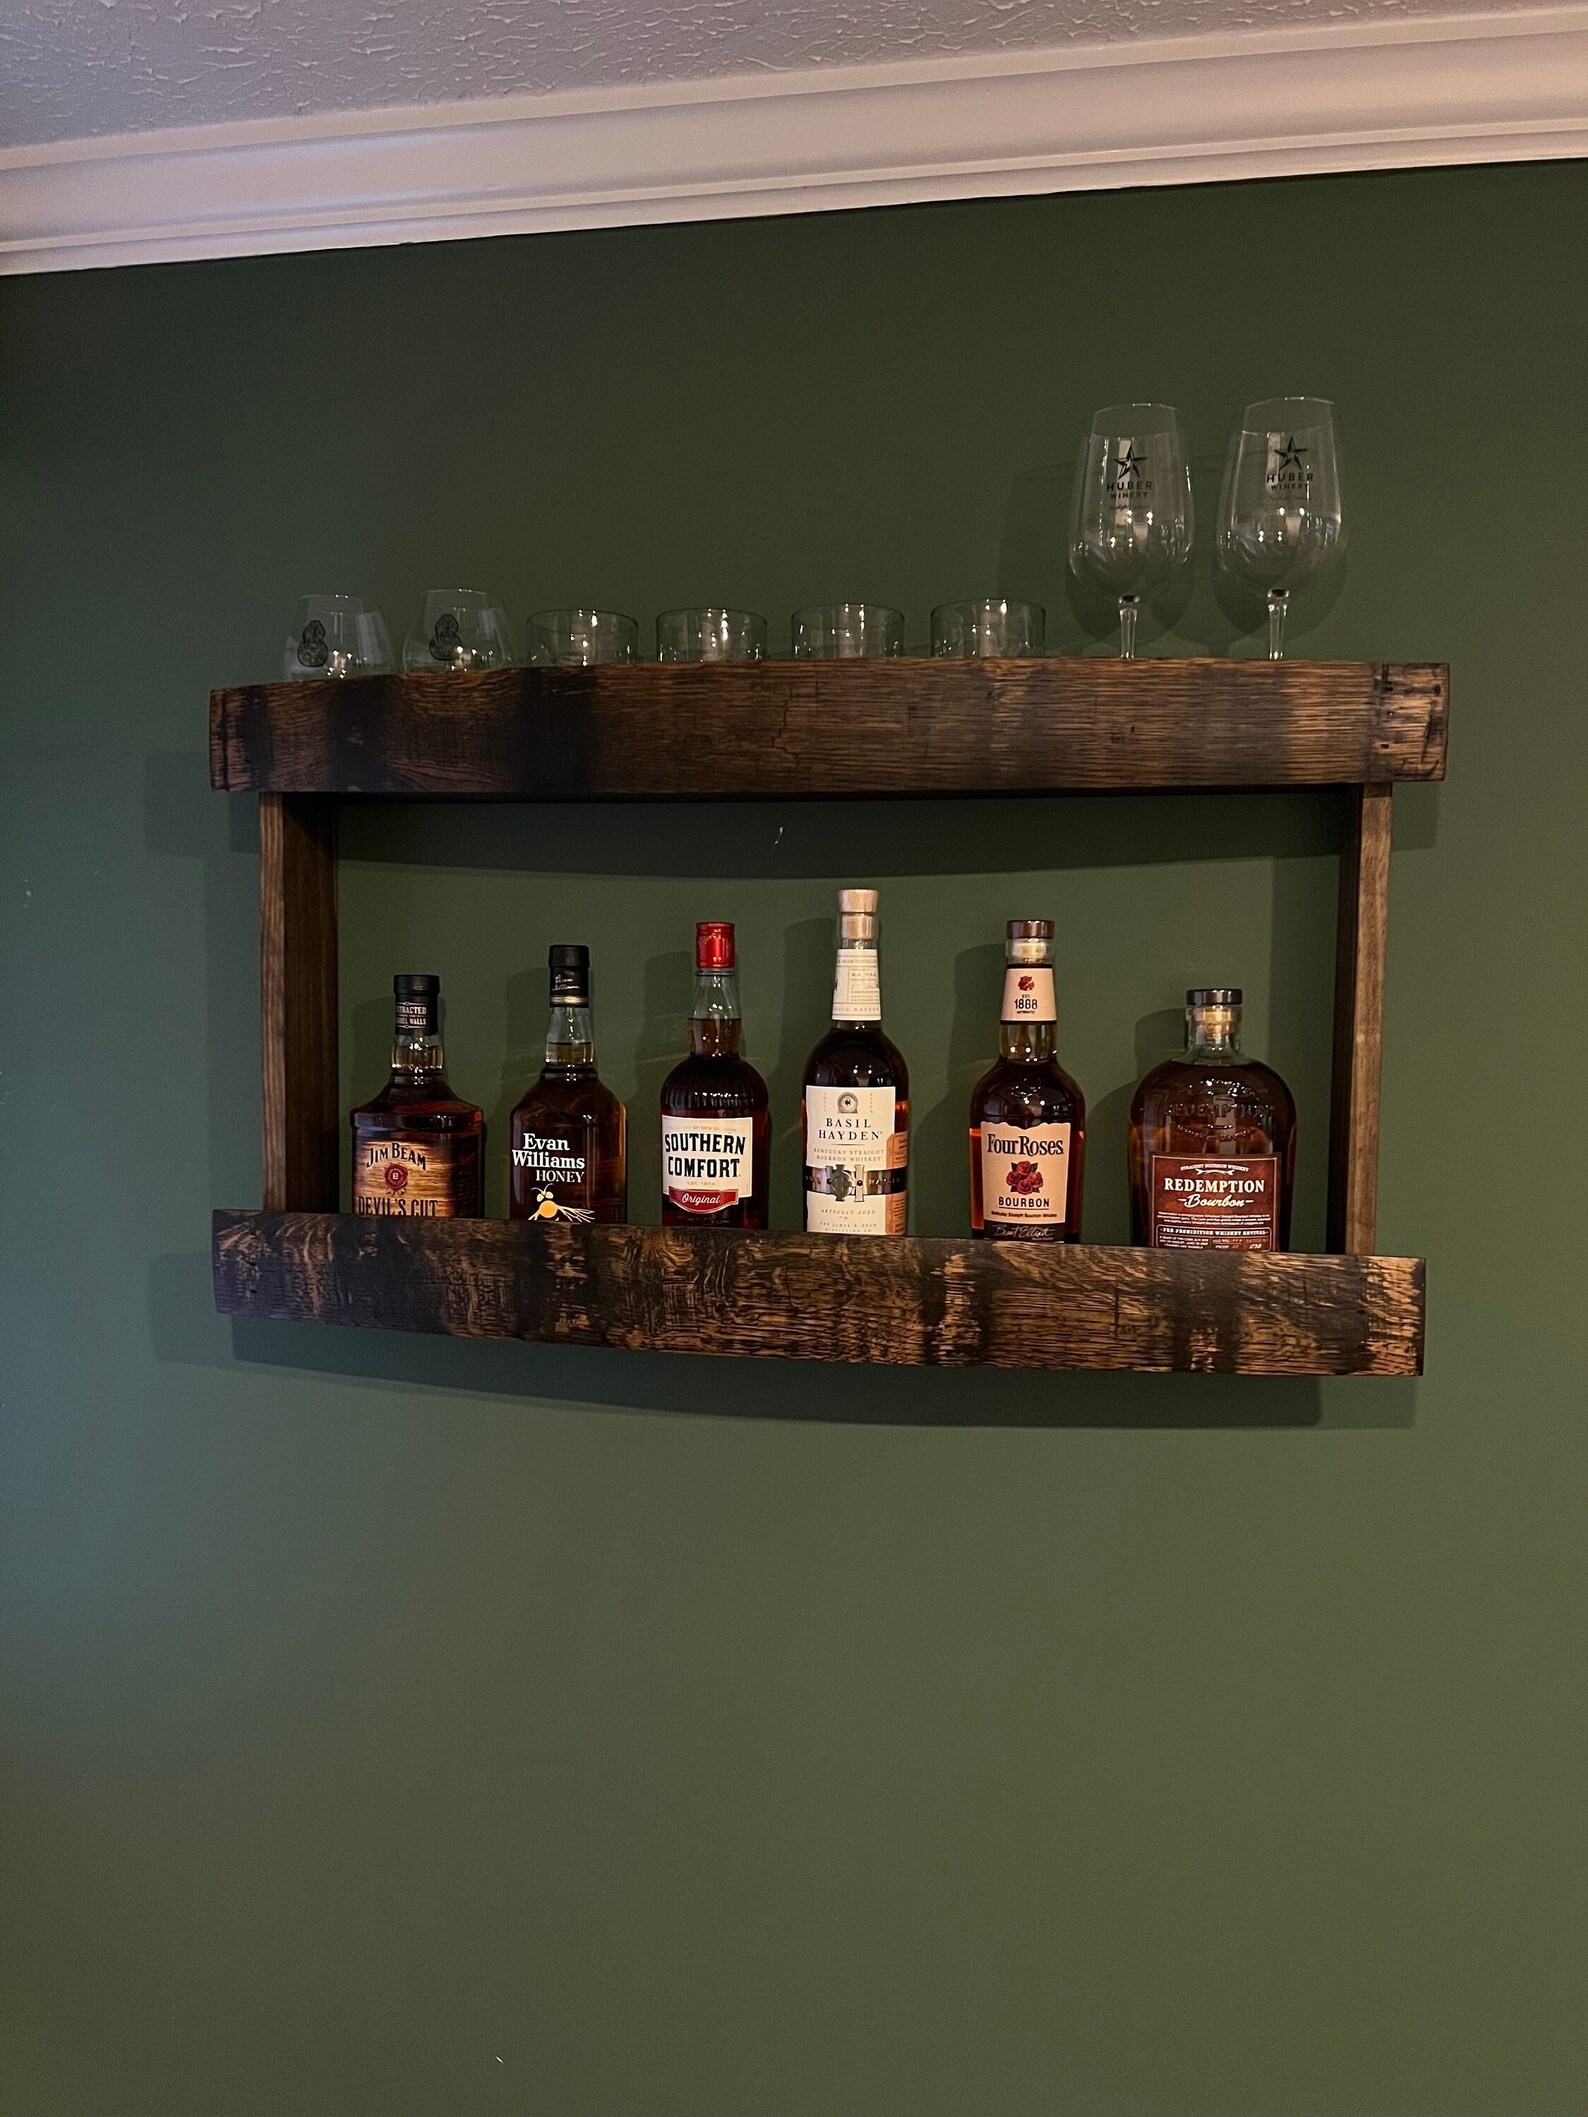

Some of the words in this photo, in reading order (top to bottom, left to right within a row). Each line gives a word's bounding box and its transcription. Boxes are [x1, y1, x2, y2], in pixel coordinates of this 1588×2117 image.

[1266, 472, 1314, 483] HUBER
[1106, 481, 1152, 492] HUBER
[1014, 999, 1038, 1009] 1888
[826, 1118, 872, 1128] BASIL
[522, 1132, 571, 1151] Evan
[818, 1130, 880, 1140] HAYDEN
[664, 1132, 747, 1155] SOUTHERN
[987, 1133, 1019, 1154] Four
[1018, 1135, 1064, 1156] Roses
[366, 1147, 389, 1168] JIM
[391, 1142, 427, 1171] BEAM
[512, 1149, 586, 1169] Williams
[667, 1156, 740, 1178] COMFORT
[535, 1169, 585, 1183] HONEY
[1164, 1178, 1265, 1193] REDEMPTION
[358, 1196, 407, 1216] DEVIL'S
[411, 1199, 438, 1217] CUT
[681, 1193, 722, 1206] Original
[998, 1196, 1050, 1207] BOURBON
[1183, 1193, 1246, 1208] Bourbon
